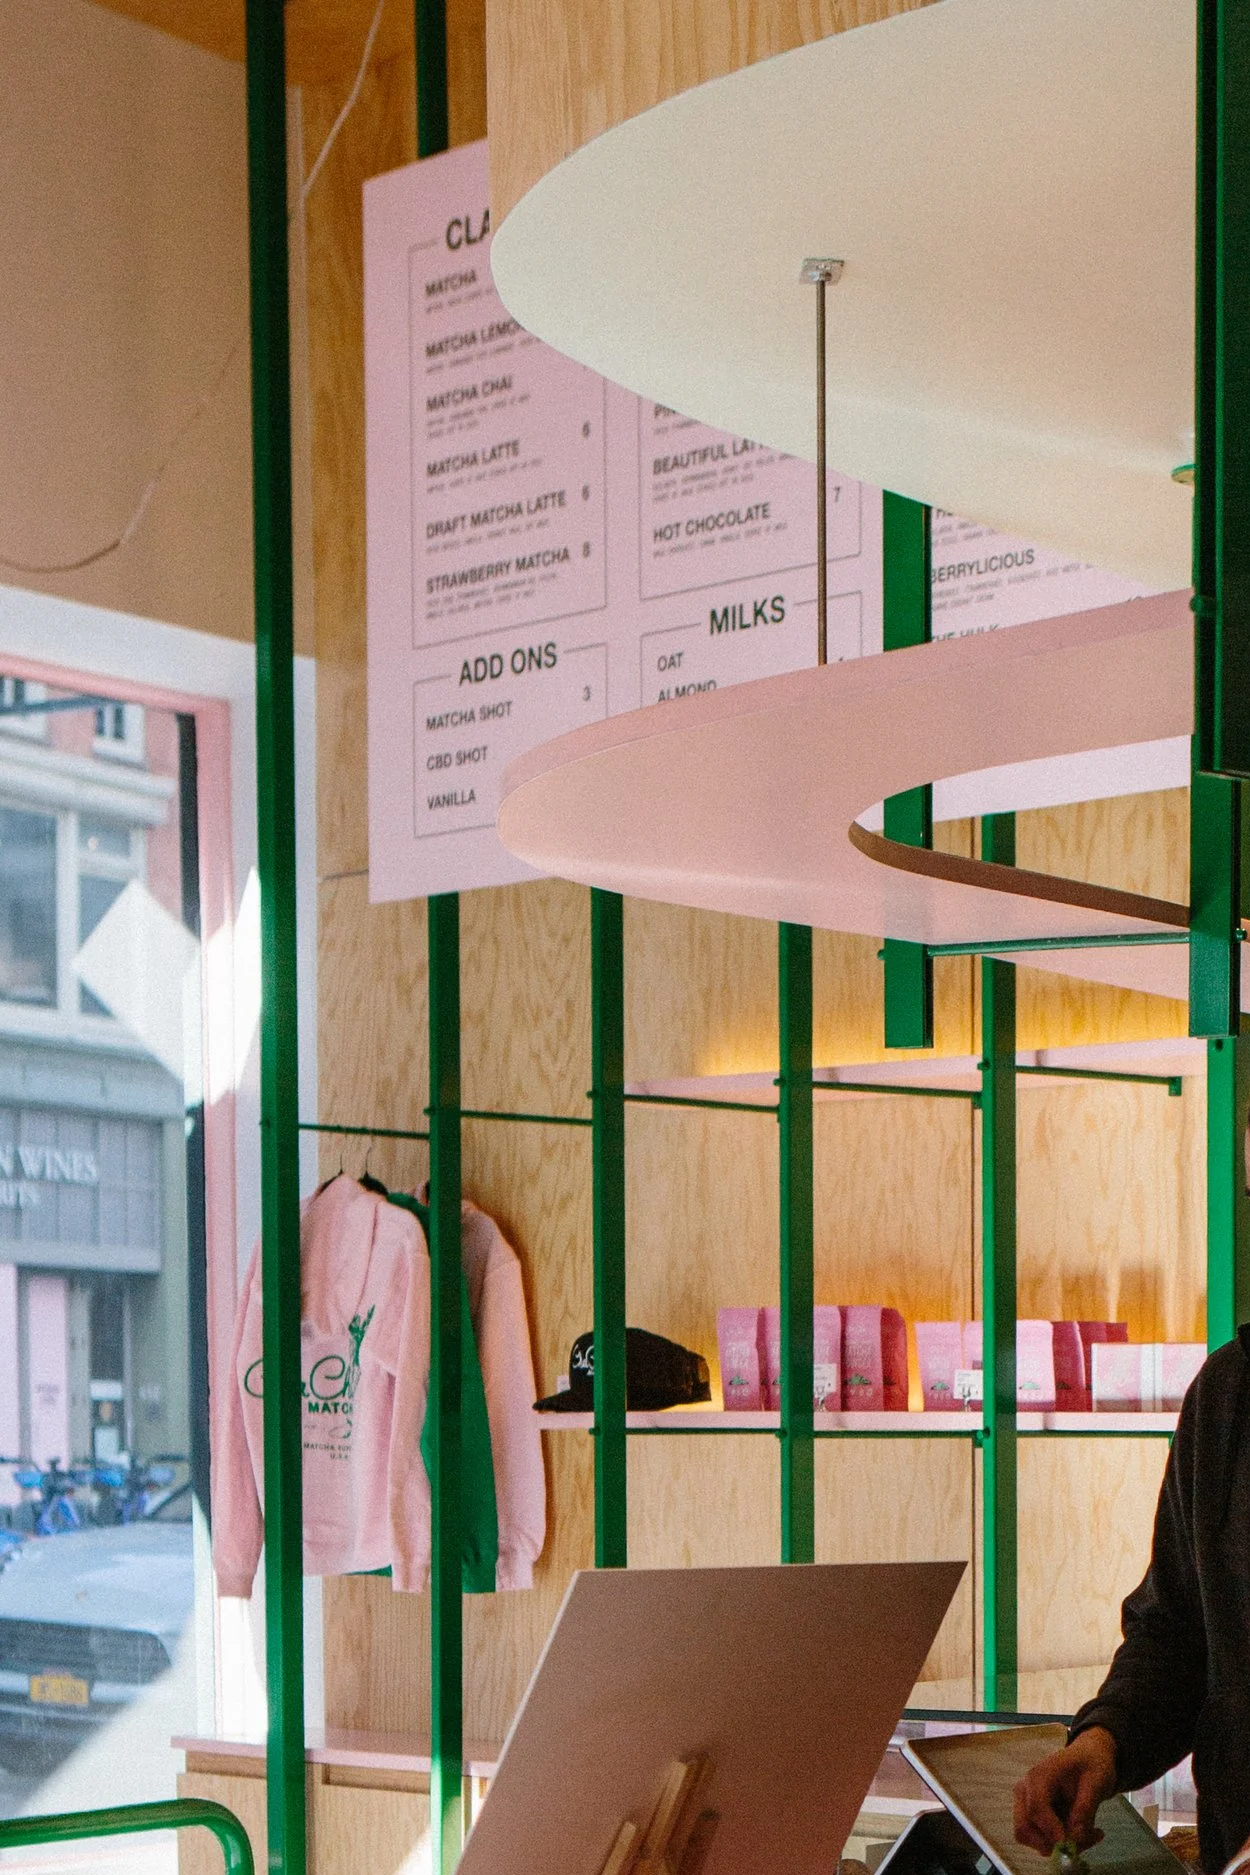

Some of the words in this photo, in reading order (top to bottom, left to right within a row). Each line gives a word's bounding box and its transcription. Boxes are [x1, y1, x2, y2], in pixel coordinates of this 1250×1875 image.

[445, 208, 490, 251] CLA
[425, 269, 477, 297] MATCHA
[425, 331, 477, 359] MATCHA
[425, 385, 478, 412] MATCHA
[426, 452, 479, 479] MATCHA
[481, 439, 520, 464] LATTE
[652, 443, 728, 476] BEAUTIFUL
[425, 514, 467, 540] DRAFT
[469, 501, 524, 529] MATCHA
[526, 489, 567, 514] LATTE
[652, 521, 682, 543] HOT
[684, 502, 771, 536] CHOCOLATE
[832, 485, 843, 503] 7
[425, 560, 512, 594] STRAWBERRY
[514, 546, 571, 572] MATCHA
[709, 593, 786, 637] MILKS
[458, 653, 505, 687] ADD
[509, 641, 558, 675] ONS
[656, 651, 685, 673] OAT
[425, 707, 476, 732] MATCHA
[479, 701, 513, 722] SHOT
[425, 752, 452, 771] CBD
[455, 745, 489, 767] SHOT
[426, 787, 477, 811] VANILLA
[18, 1146, 98, 1183] WINES
